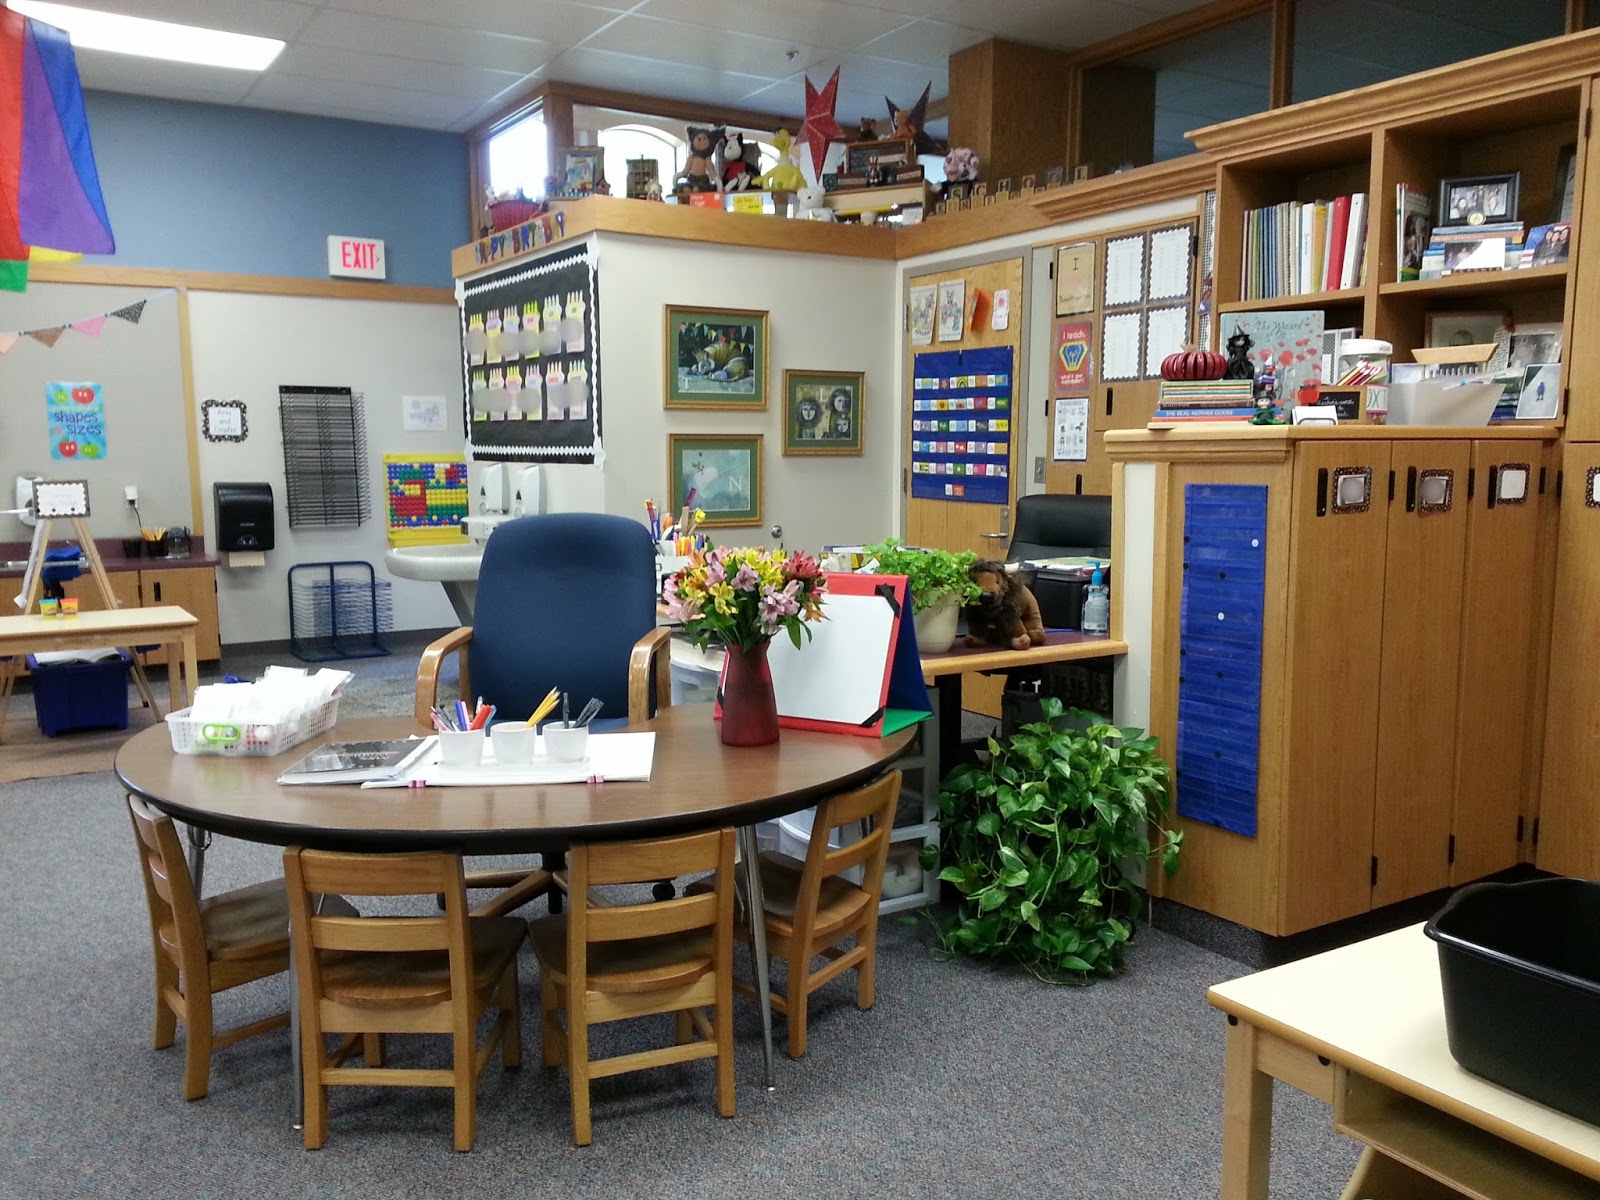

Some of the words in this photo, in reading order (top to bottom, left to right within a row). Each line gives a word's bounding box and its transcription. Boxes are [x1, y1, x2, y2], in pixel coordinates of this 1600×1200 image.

[341, 241, 376, 270] EXIT
[1255, 319, 1270, 331] The
[1273, 319, 1304, 330] Wizard
[681, 377, 692, 390] T
[54, 411, 98, 424] shapes
[66, 423, 102, 436] sizes
[729, 476, 742, 491] N
